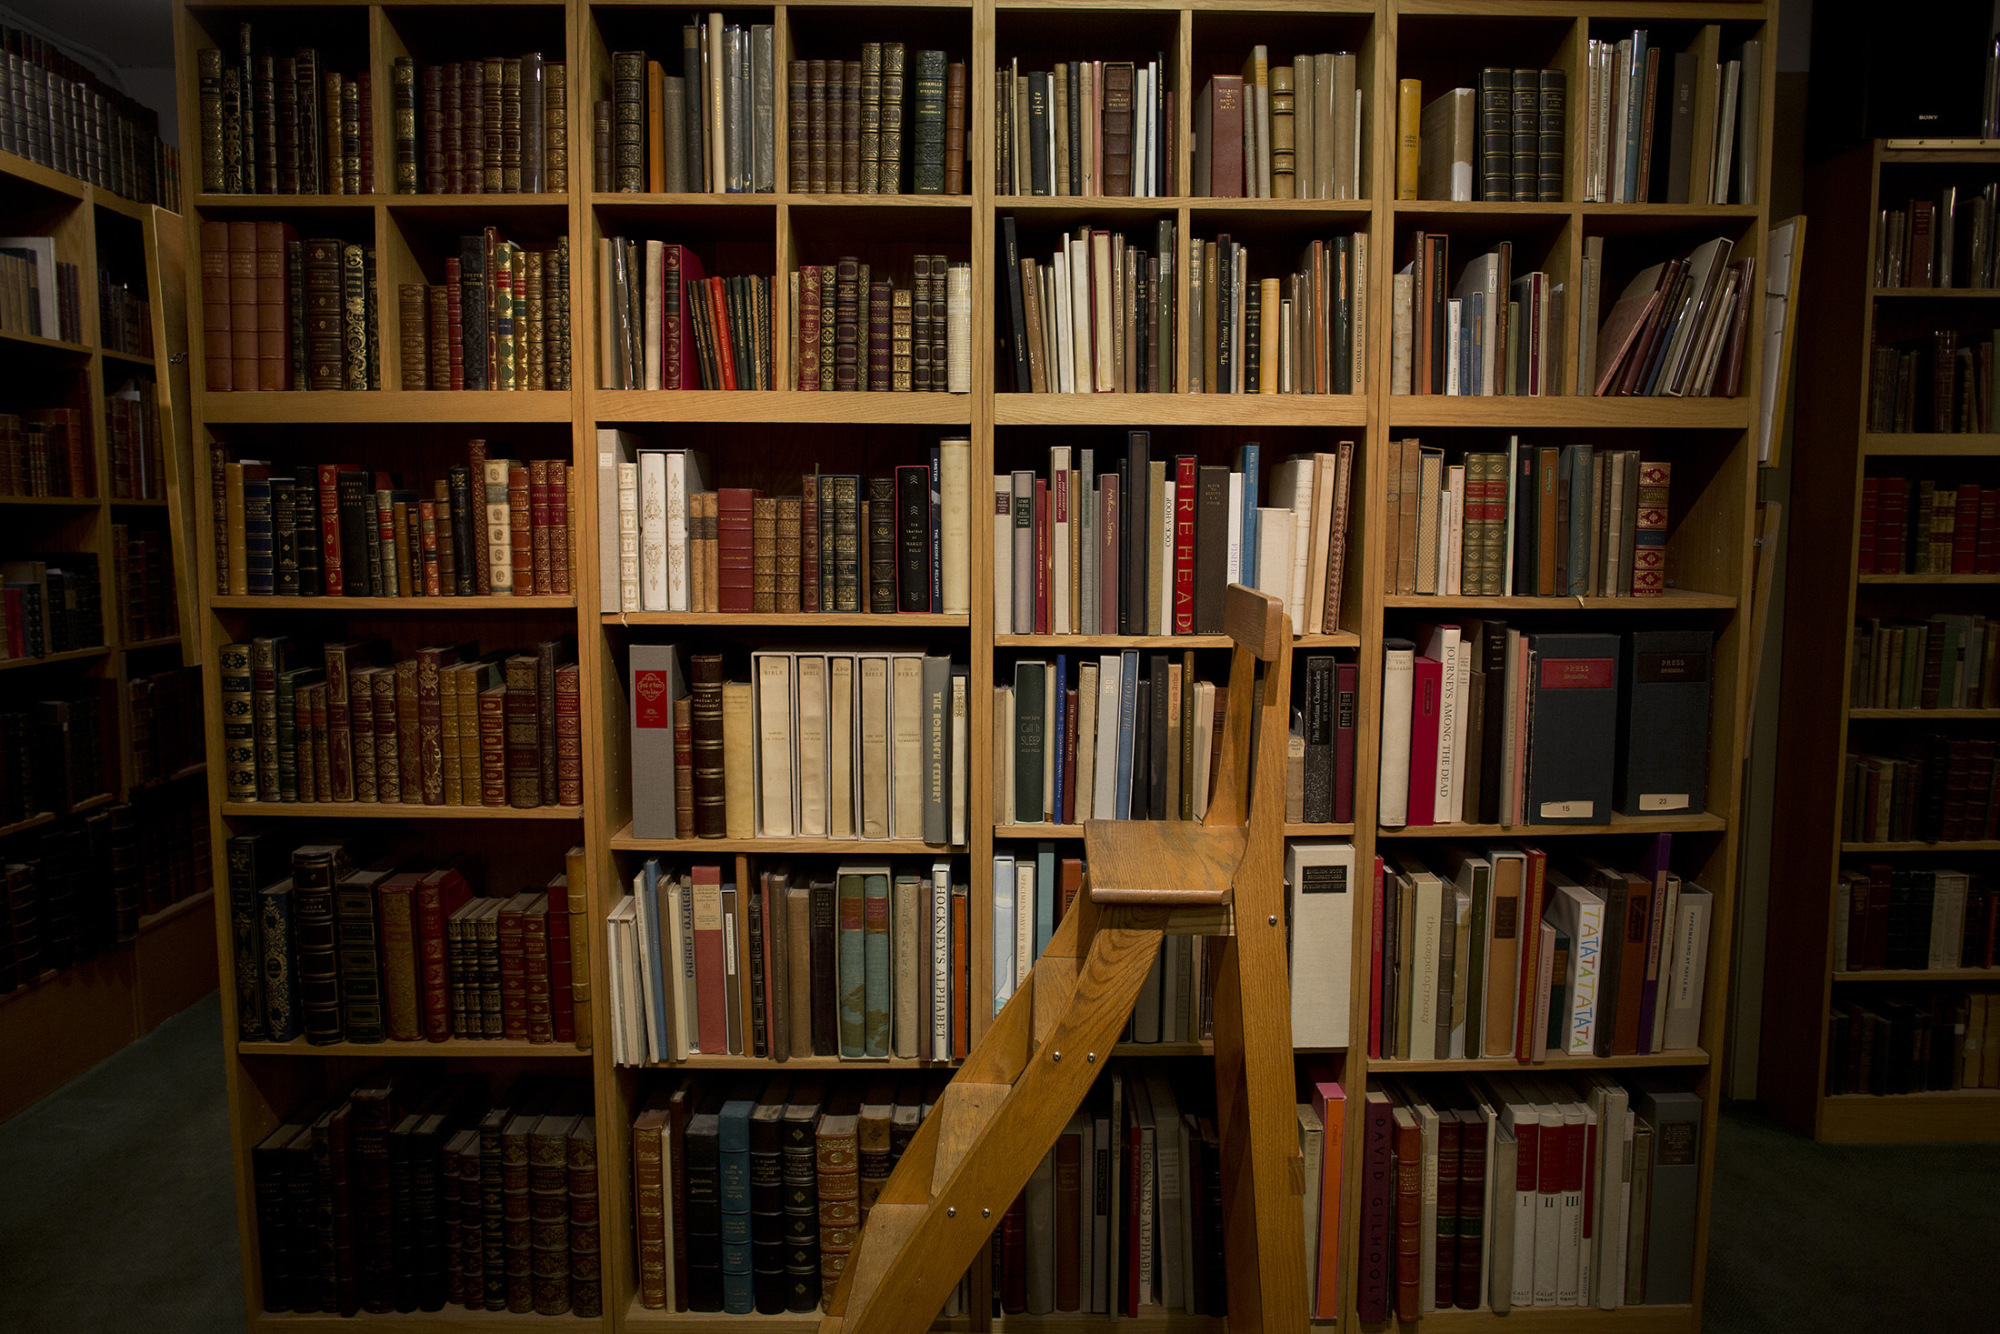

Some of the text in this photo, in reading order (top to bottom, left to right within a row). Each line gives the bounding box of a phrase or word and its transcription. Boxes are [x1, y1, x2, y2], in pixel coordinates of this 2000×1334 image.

[1221, 259, 1230, 286] Stendhal
[1220, 297, 1230, 324] Journals
[1220, 326, 1230, 348] Private
[1221, 351, 1230, 365] The
[1177, 462, 1194, 628] FIREHEAD
[1123, 677, 1134, 730] COLETTE
[1311, 670, 1320, 742] The Martian Chronicles
[1020, 723, 1040, 734] Call It
[1440, 646, 1456, 798] JOURNEYS AMONG THE DEAD
[932, 692, 942, 804] THE NONESUCH CENTURY
[1020, 736, 1040, 746] SLEEP
[1020, 933, 1026, 943] BY
[1426, 916, 1434, 936] the
[1686, 912, 1695, 956] PAPERMAKING
[936, 884, 946, 1040] HOCKNEY'S ALPHABET
[1686, 956, 1690, 964] AT
[1141, 1141, 1152, 1285] HOCKNEY'S ALPHABET
[1369, 1118, 1386, 1306] DAVID GILHOOLY
[1523, 1196, 1527, 1206] I
[1545, 1197, 1554, 1208] II
[1566, 1196, 1578, 1206] III
